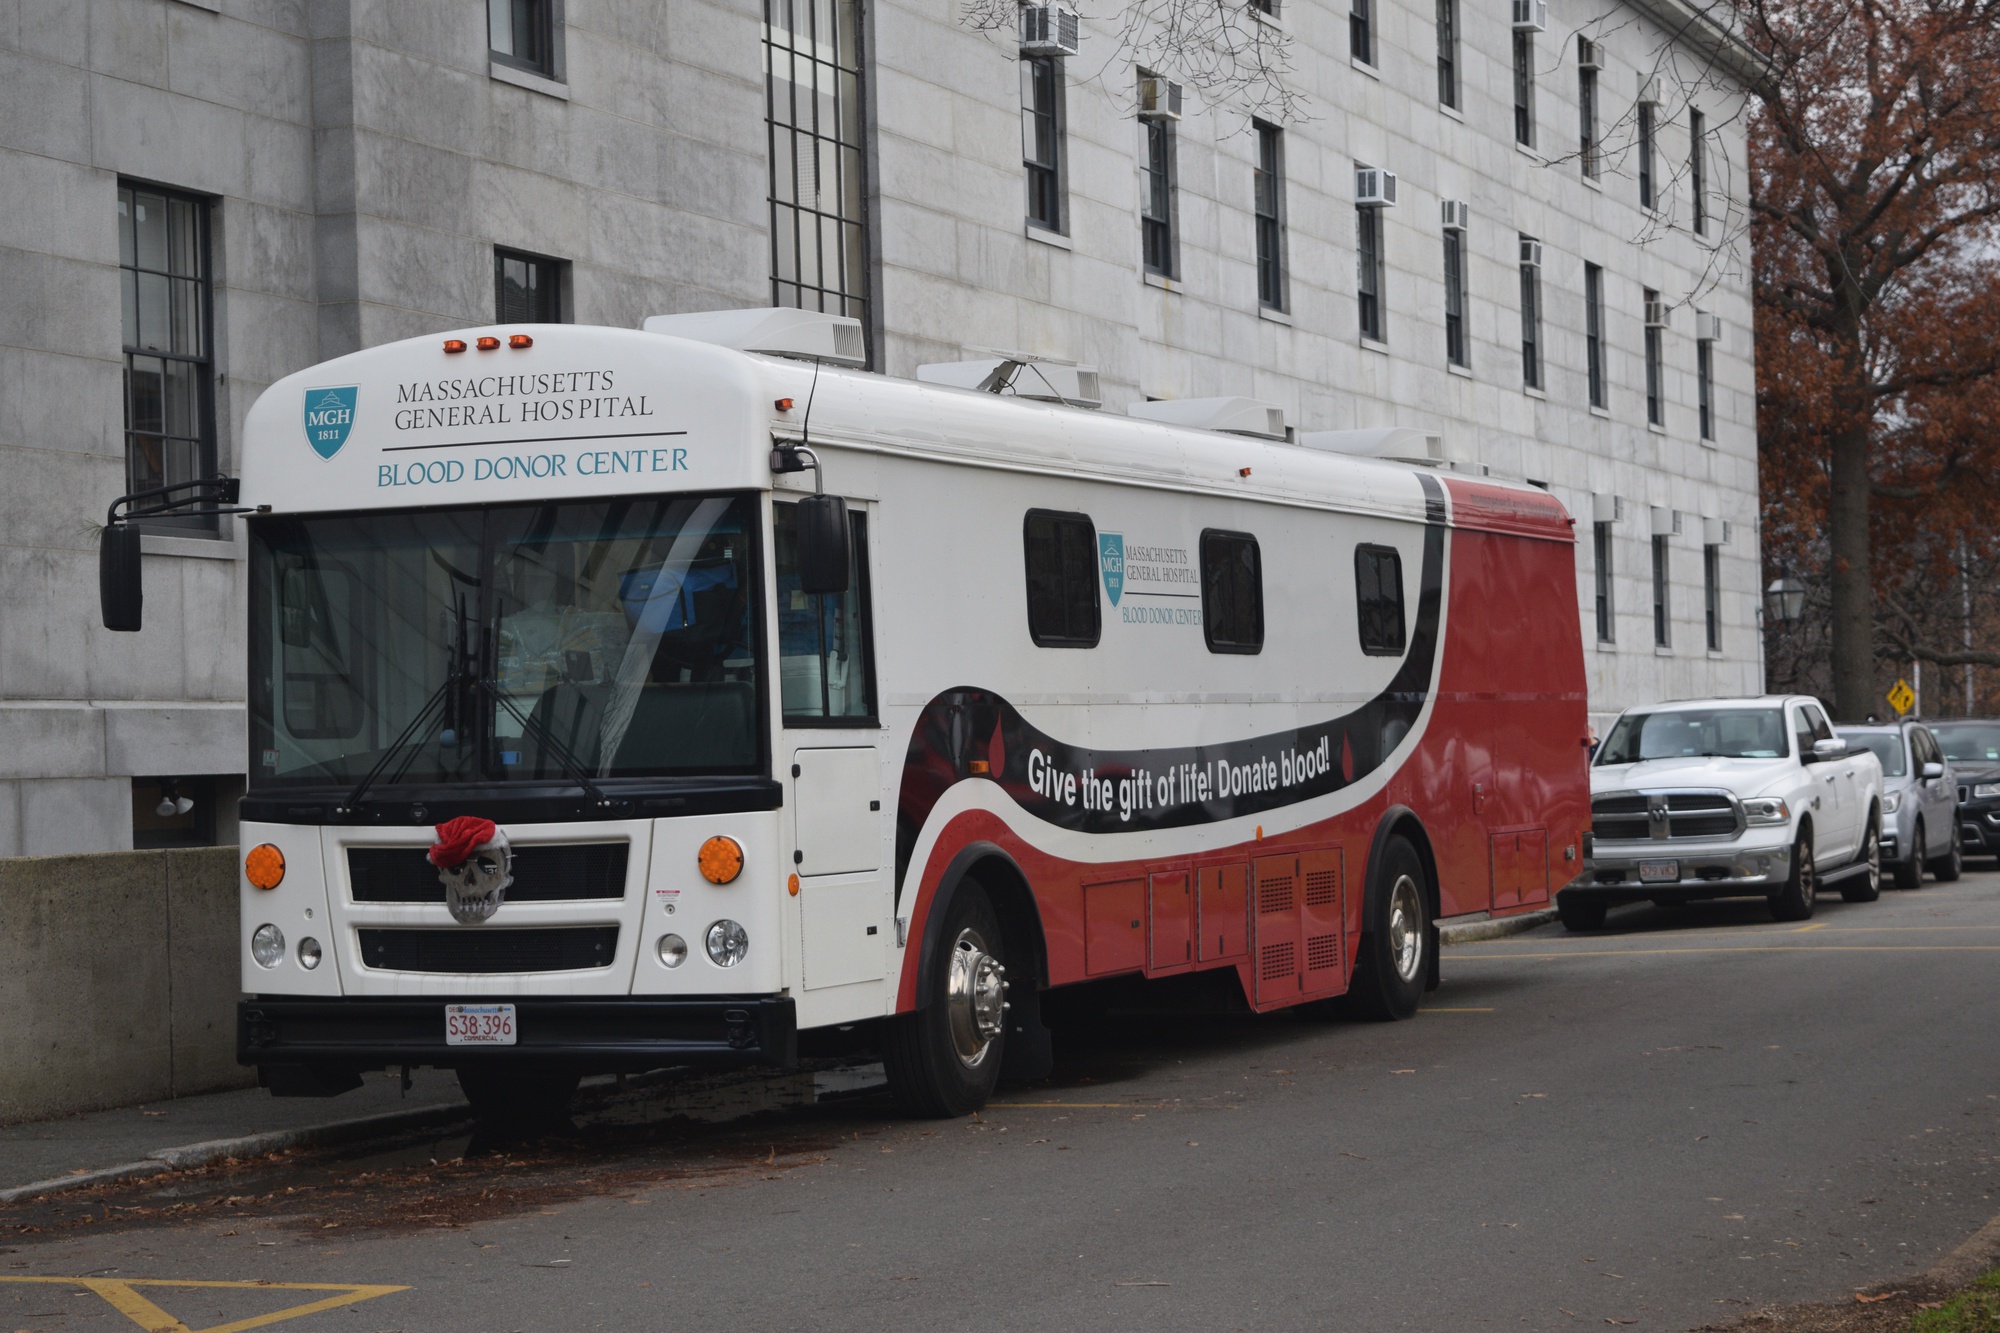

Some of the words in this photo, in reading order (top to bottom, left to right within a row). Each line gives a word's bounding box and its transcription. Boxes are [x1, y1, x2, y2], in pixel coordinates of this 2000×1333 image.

[397, 370, 614, 403] MASSACHUSETTS
[308, 409, 351, 426] MGH
[395, 404, 511, 430] GENERAL
[521, 396, 654, 422] HOSPITAL
[318, 430, 340, 440] 1811
[377, 460, 464, 487] BLOOD
[474, 454, 567, 481] DONOR
[576, 448, 689, 475] CENTER
[1125, 545, 1188, 564] MASSACHUSETTS
[1103, 557, 1123, 572] MGH
[1108, 577, 1119, 588] 1811
[1126, 565, 1161, 582] GENERAL
[1162, 567, 1199, 584] HOSPITAL
[1122, 606, 1148, 624] BLOOD
[1149, 607, 1174, 625] DONOR
[1175, 608, 1203, 626] CENTER
[1028, 748, 1077, 806] Give
[1081, 768, 1114, 811] the
[1119, 768, 1153, 822] gift
[1157, 765, 1175, 806] of
[1180, 762, 1213, 802] life!
[1218, 755, 1278, 798] Donate
[1281, 735, 1330, 787] blood!
